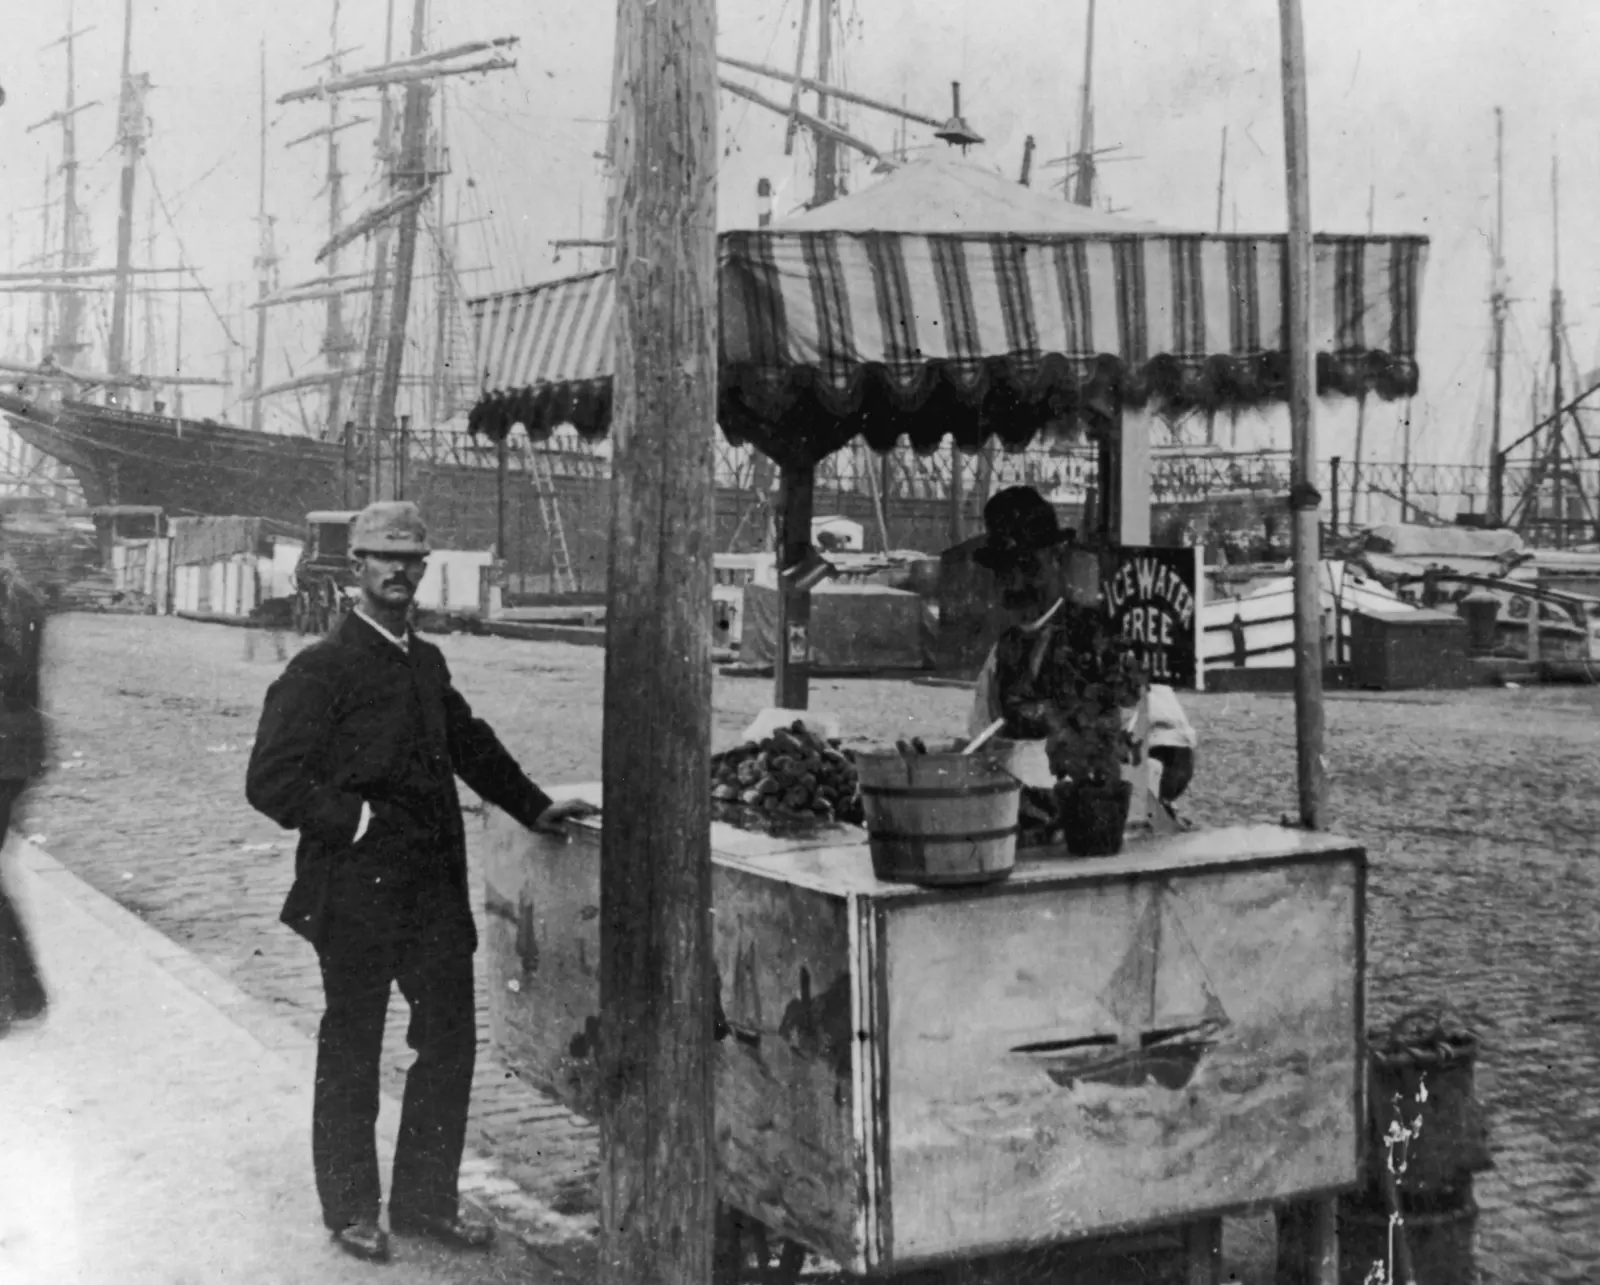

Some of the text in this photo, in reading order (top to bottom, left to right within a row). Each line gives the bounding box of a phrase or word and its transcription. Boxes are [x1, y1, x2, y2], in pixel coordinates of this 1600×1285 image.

[1104, 557, 1193, 630] ICE WATER
[1123, 607, 1173, 645] FREE
